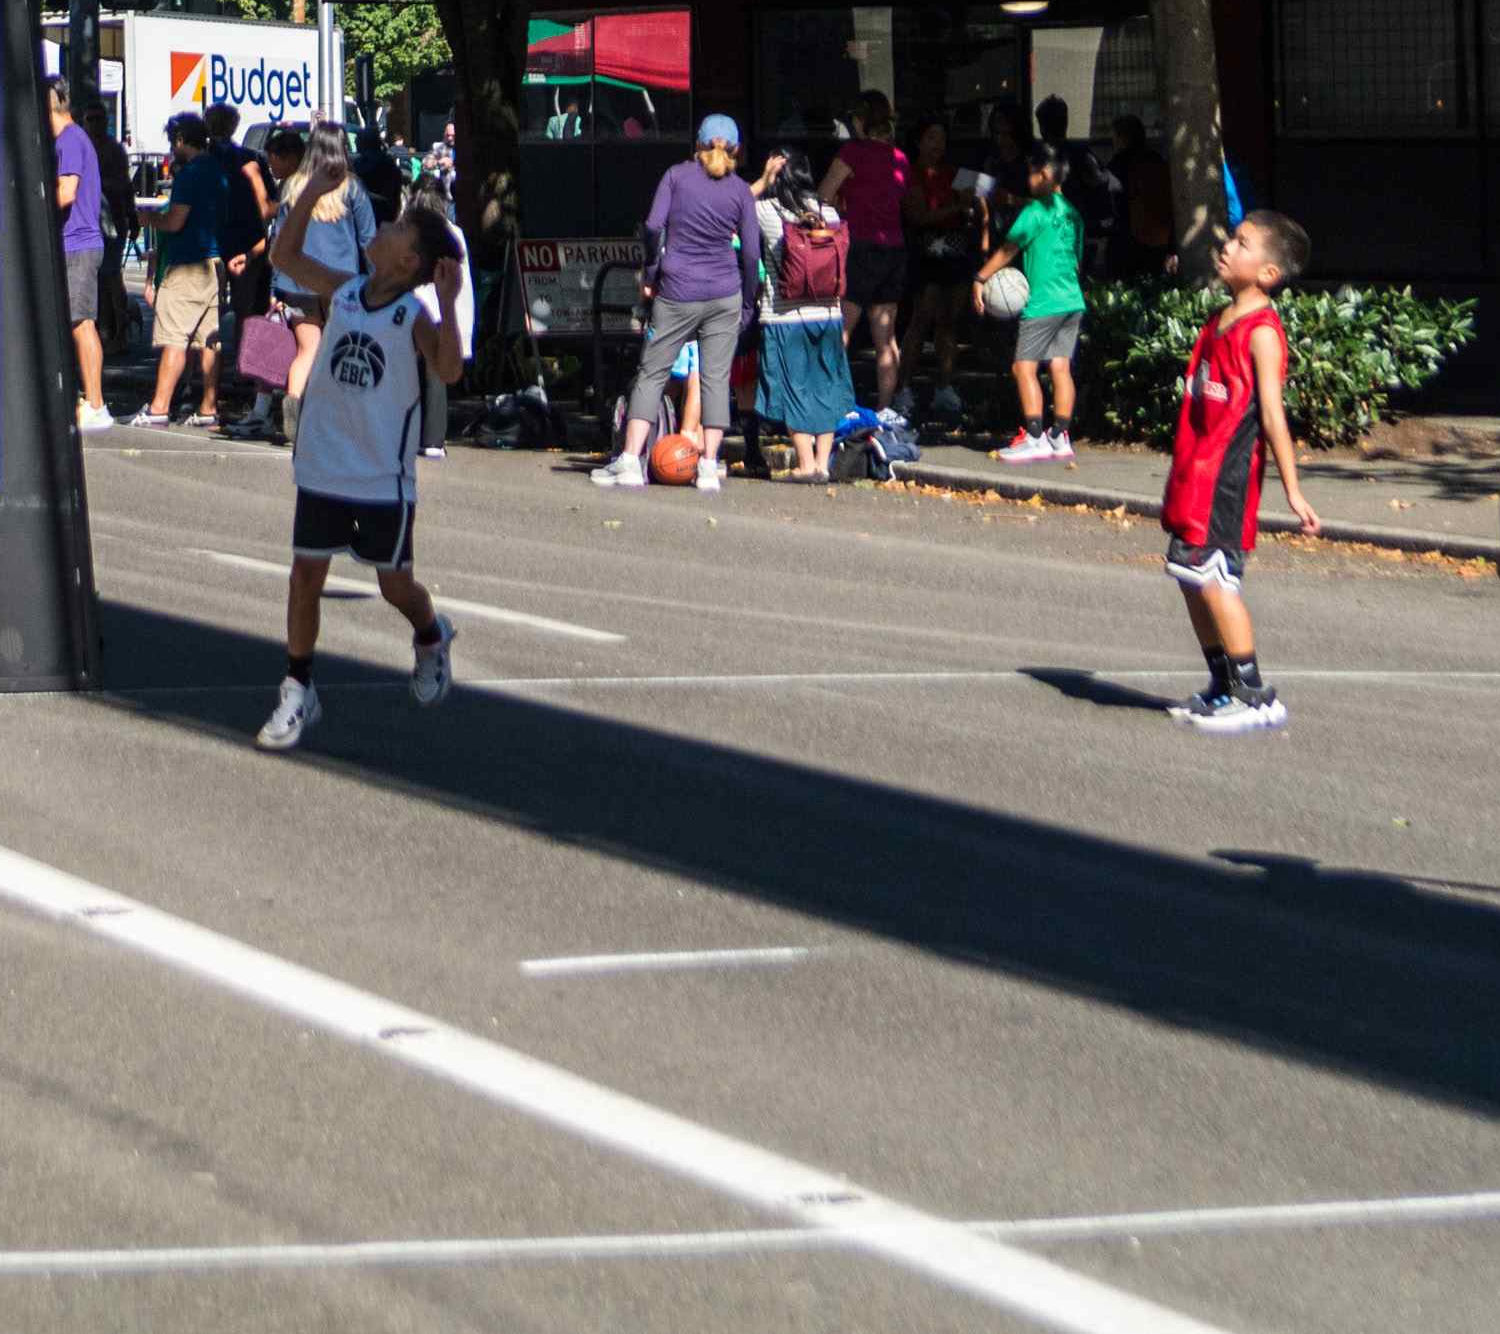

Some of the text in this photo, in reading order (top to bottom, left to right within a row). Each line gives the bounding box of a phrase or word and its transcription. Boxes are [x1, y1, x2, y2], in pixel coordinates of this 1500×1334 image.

[211, 54, 312, 120] Budget
[523, 244, 642, 268] NO PARKING
[393, 305, 407, 325] 8
